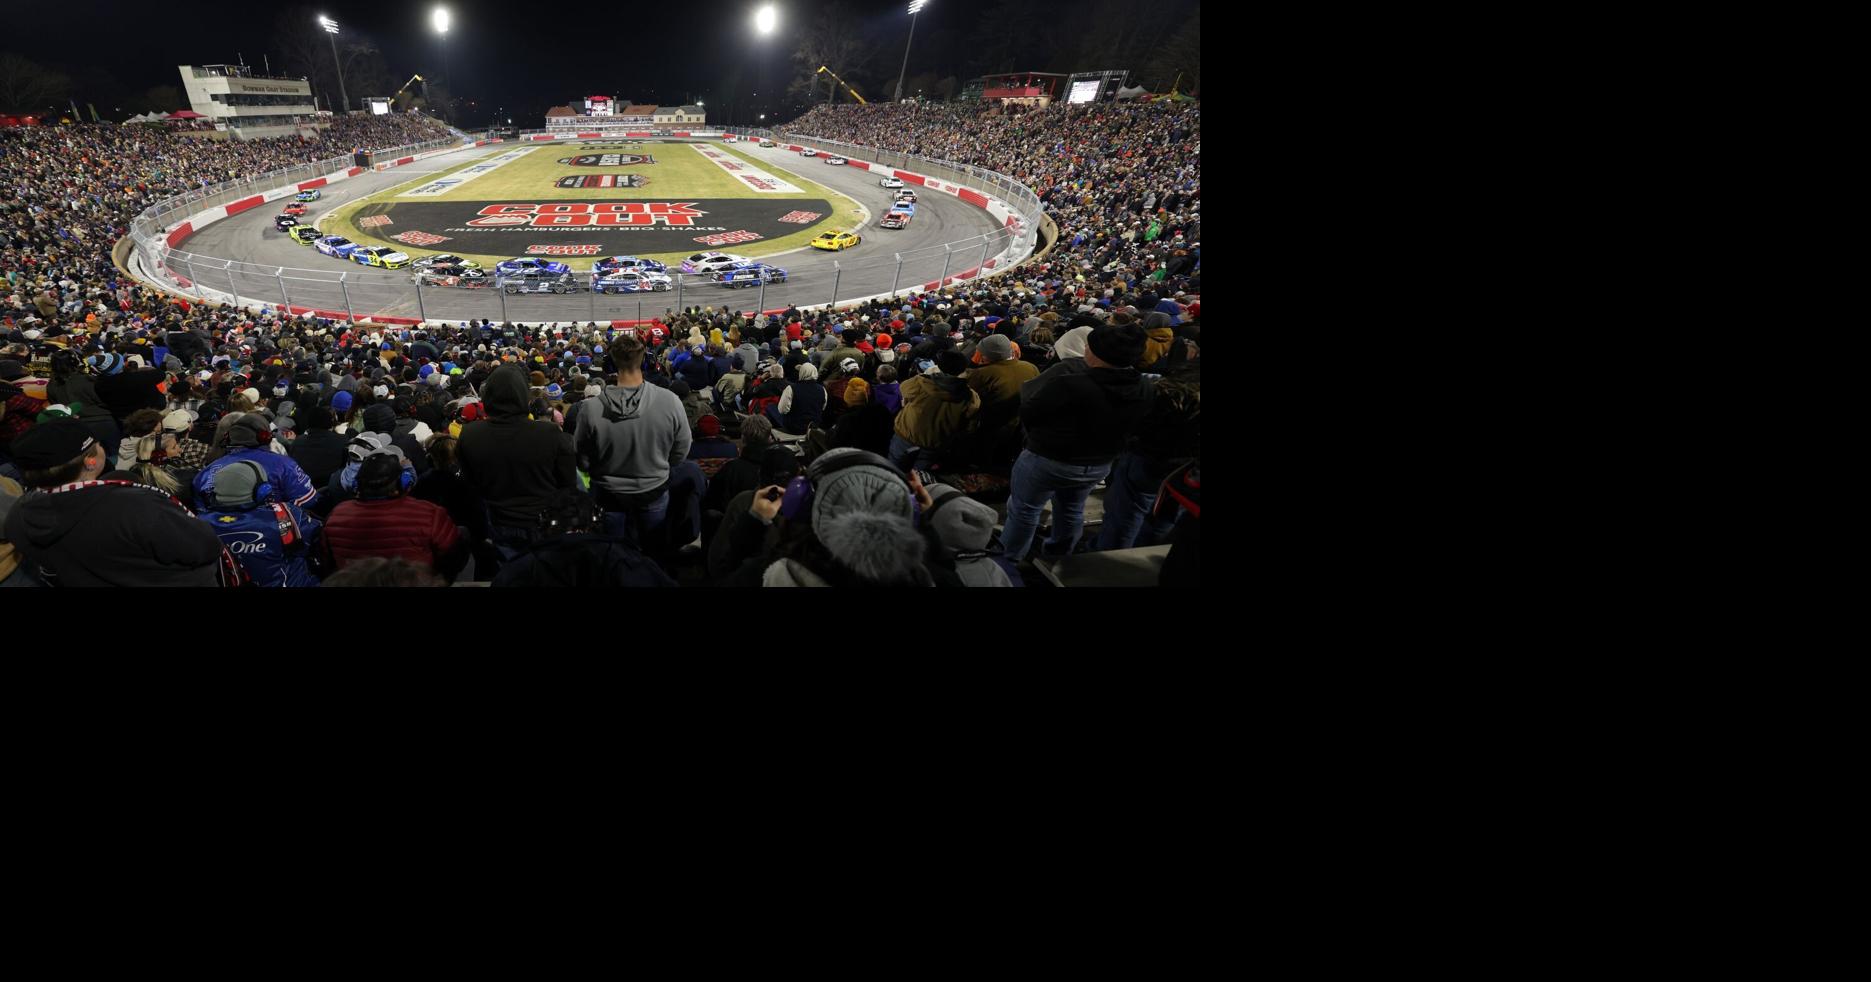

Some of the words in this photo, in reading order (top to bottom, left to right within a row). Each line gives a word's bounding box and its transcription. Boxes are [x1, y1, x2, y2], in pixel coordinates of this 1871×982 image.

[477, 203, 709, 215] COOK
[529, 213, 703, 227] OUT
[369, 256, 379, 265] 34
[230, 540, 266, 554] One
